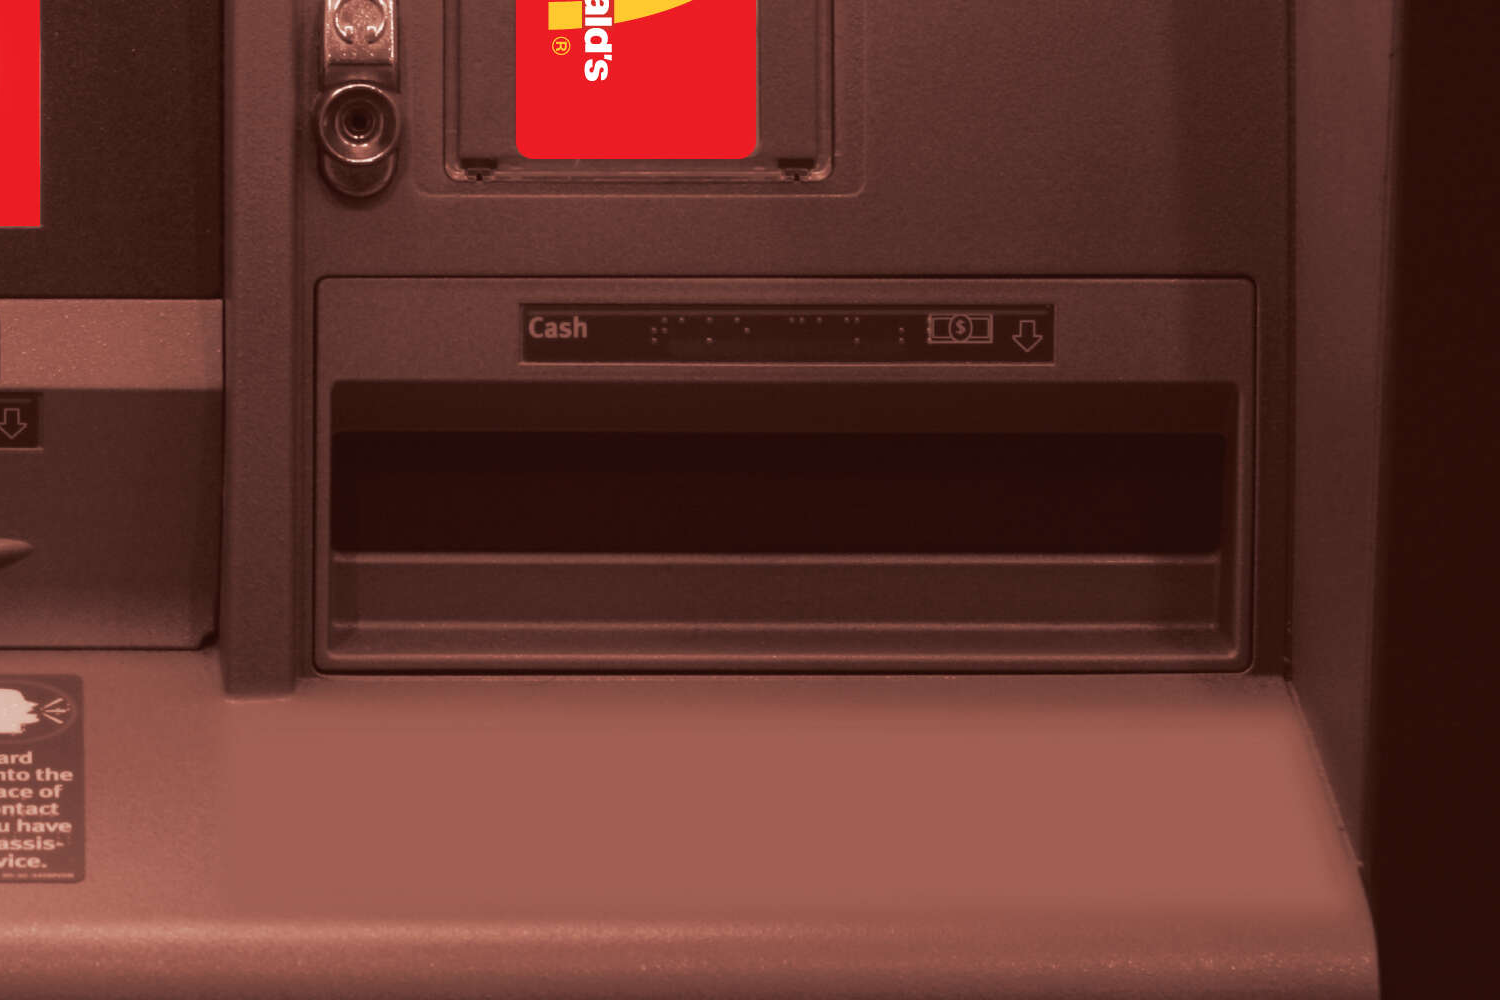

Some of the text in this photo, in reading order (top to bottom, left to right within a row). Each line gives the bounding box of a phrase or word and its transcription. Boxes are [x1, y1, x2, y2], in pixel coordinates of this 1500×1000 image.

[529, 317, 588, 339] Cash
[35, 767, 74, 782] the
[39, 784, 63, 798] of
[16, 818, 72, 833] have
